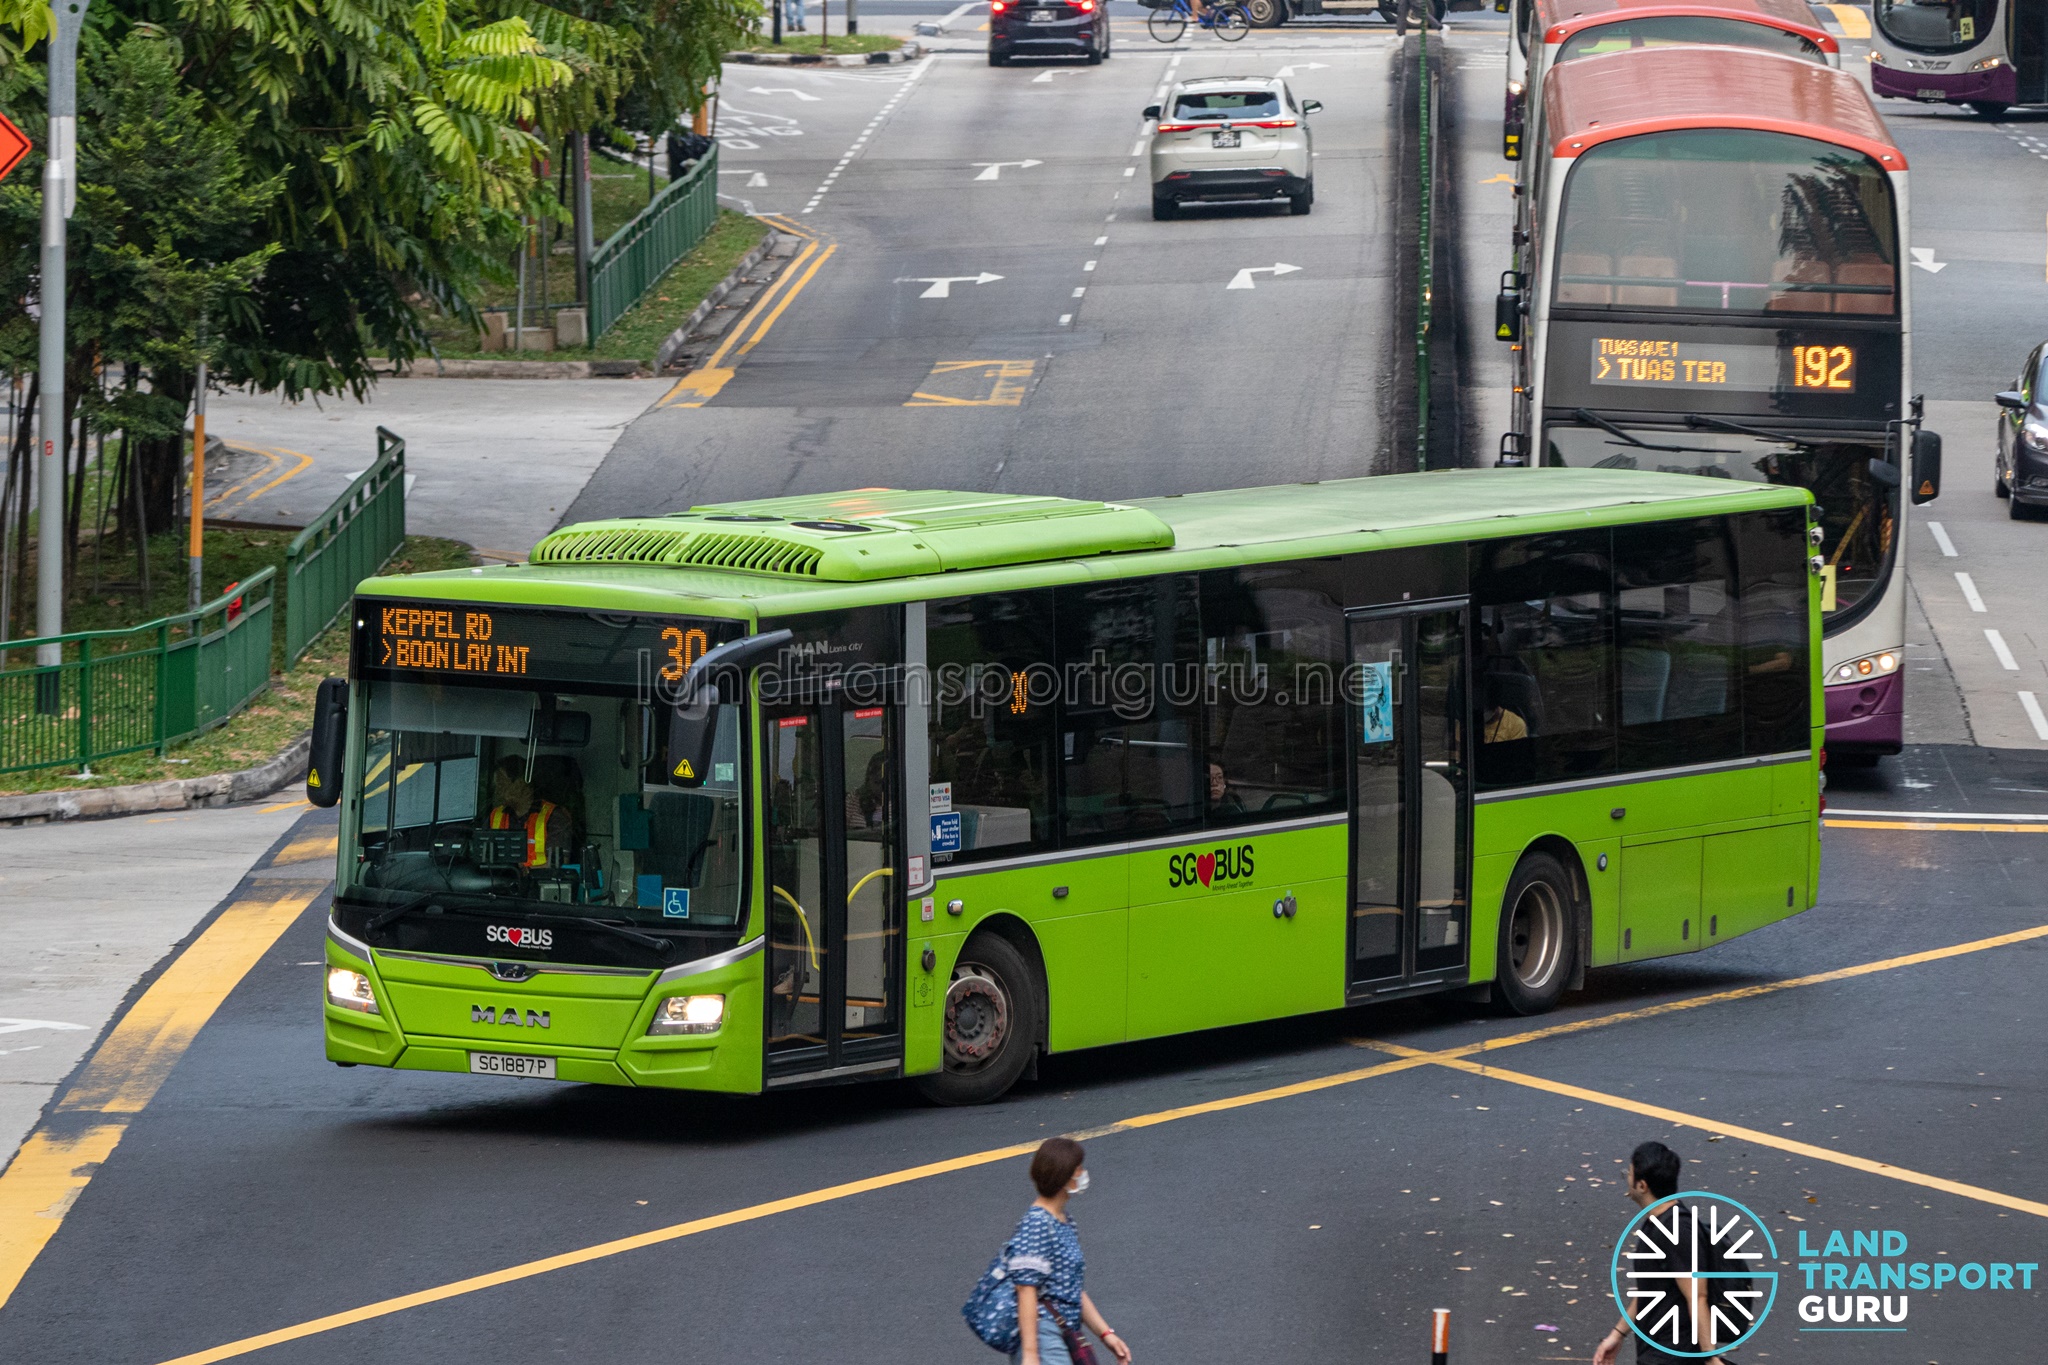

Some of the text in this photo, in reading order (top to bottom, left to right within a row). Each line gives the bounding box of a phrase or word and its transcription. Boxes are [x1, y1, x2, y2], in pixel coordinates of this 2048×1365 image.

[1617, 357, 1727, 383] TUAS TER
[1793, 346, 1852, 388] 192
[382, 608, 493, 641] KEPPEL RD
[396, 639, 530, 674] BOON LAY INT
[661, 627, 707, 681] 30
[790, 640, 828, 657] MAN
[1011, 671, 1027, 714] 30
[471, 1005, 551, 1029] MAN
[479, 1055, 547, 1074] SG1887P
